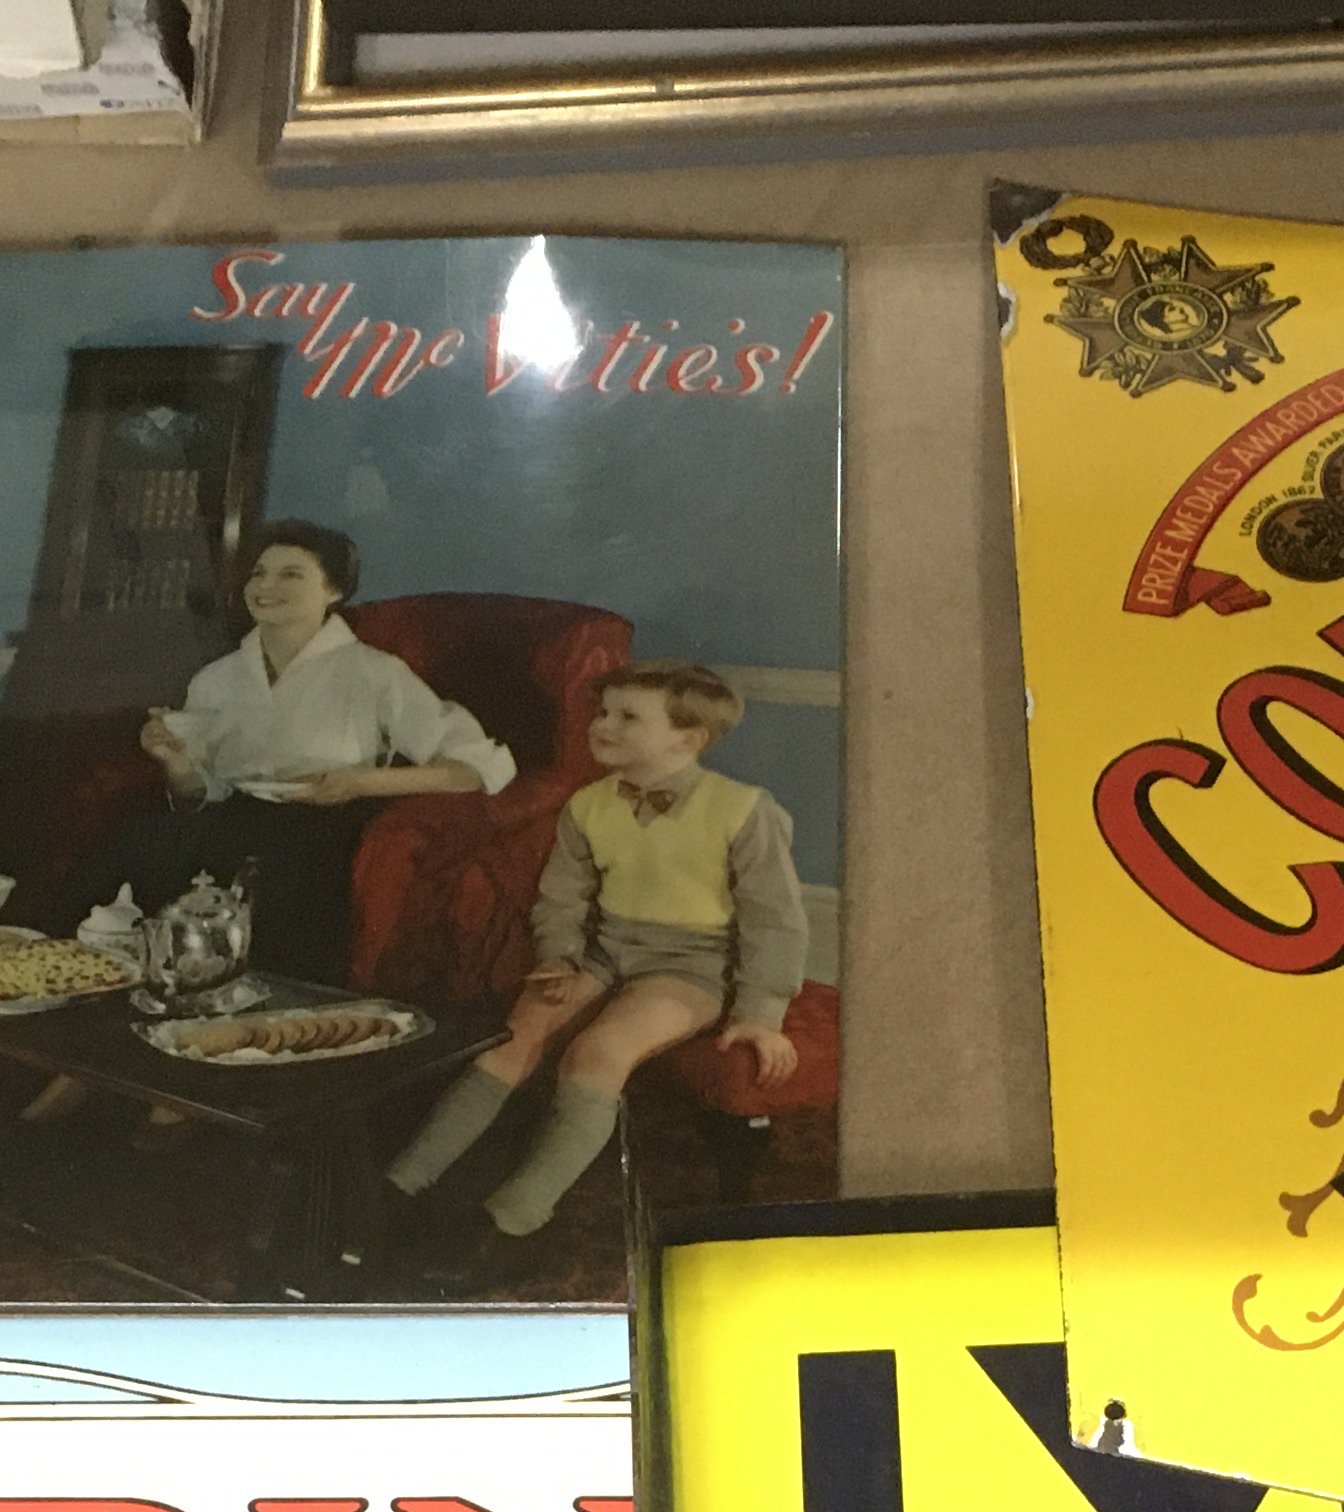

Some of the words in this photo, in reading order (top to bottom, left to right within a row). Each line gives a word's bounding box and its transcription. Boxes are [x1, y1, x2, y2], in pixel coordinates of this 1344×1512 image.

[190, 248, 355, 361] Say
[1137, 541, 1188, 605] PRIZE
[1164, 461, 1243, 542] MEDALS
[1239, 494, 1278, 536] LONDON
